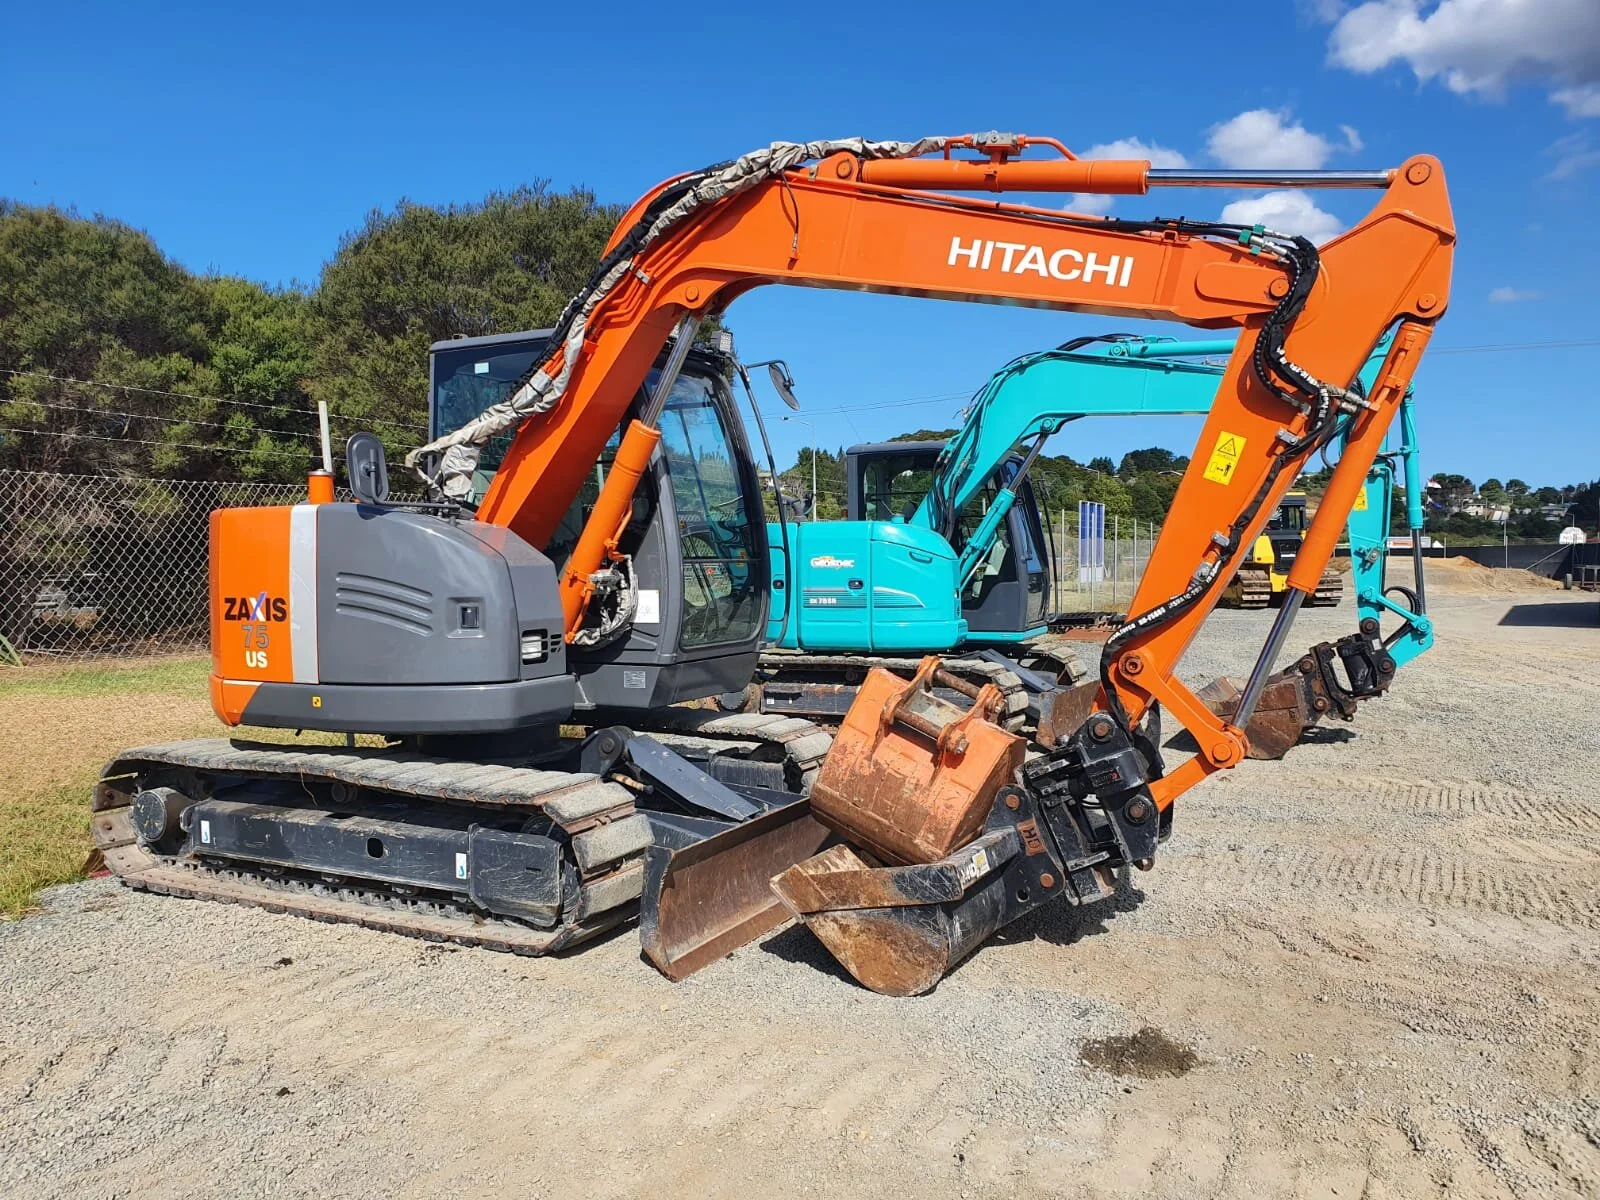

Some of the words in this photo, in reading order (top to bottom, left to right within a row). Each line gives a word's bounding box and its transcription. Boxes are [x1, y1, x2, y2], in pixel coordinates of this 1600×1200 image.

[947, 236, 1134, 287] HITACHI
[224, 592, 287, 622] ZAXIS
[241, 624, 269, 648] 75
[245, 650, 268, 668] US
